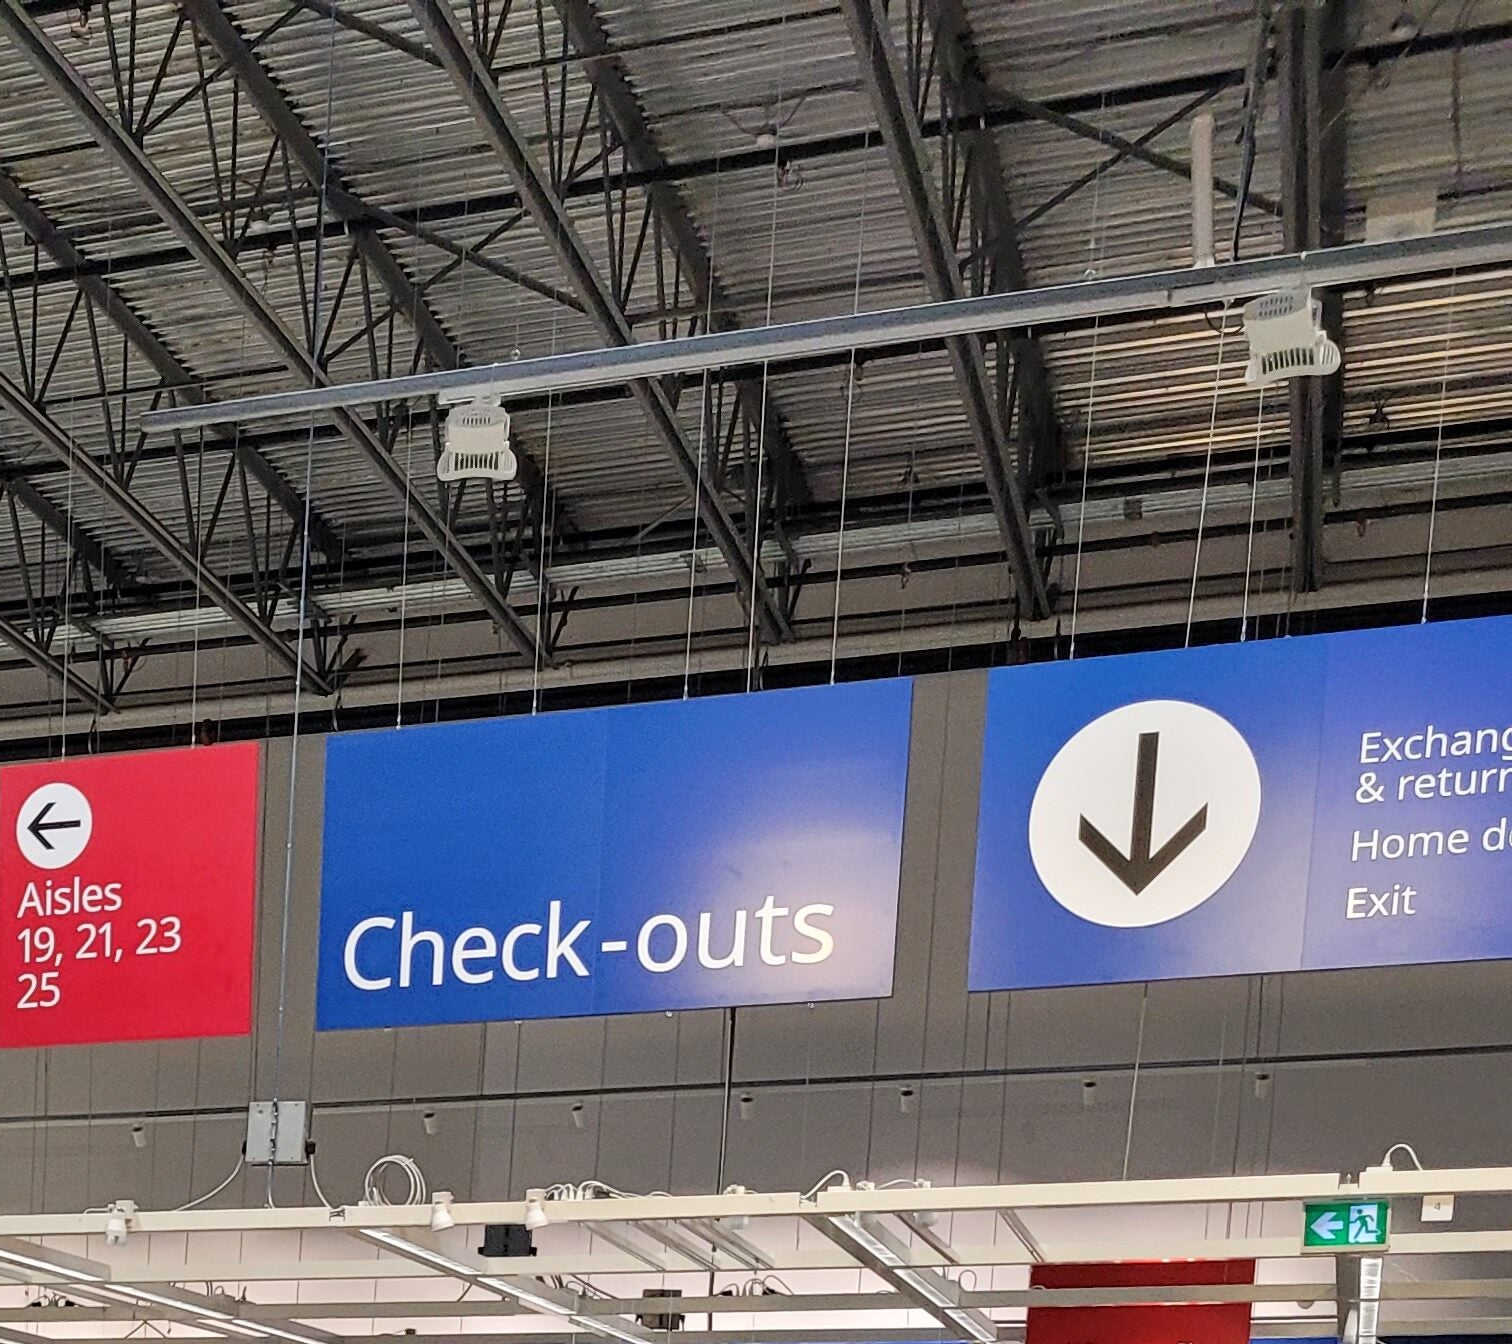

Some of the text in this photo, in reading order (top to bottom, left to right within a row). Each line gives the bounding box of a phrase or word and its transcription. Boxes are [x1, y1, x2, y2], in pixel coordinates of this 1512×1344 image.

[1355, 771, 1385, 804] &
[1351, 829, 1470, 863] Home
[16, 876, 123, 919] Aisles
[1346, 884, 1417, 920] Exit
[17, 916, 182, 967] 19, 21, 23
[342, 895, 836, 991] Check-outs
[16, 971, 61, 1009] 25
